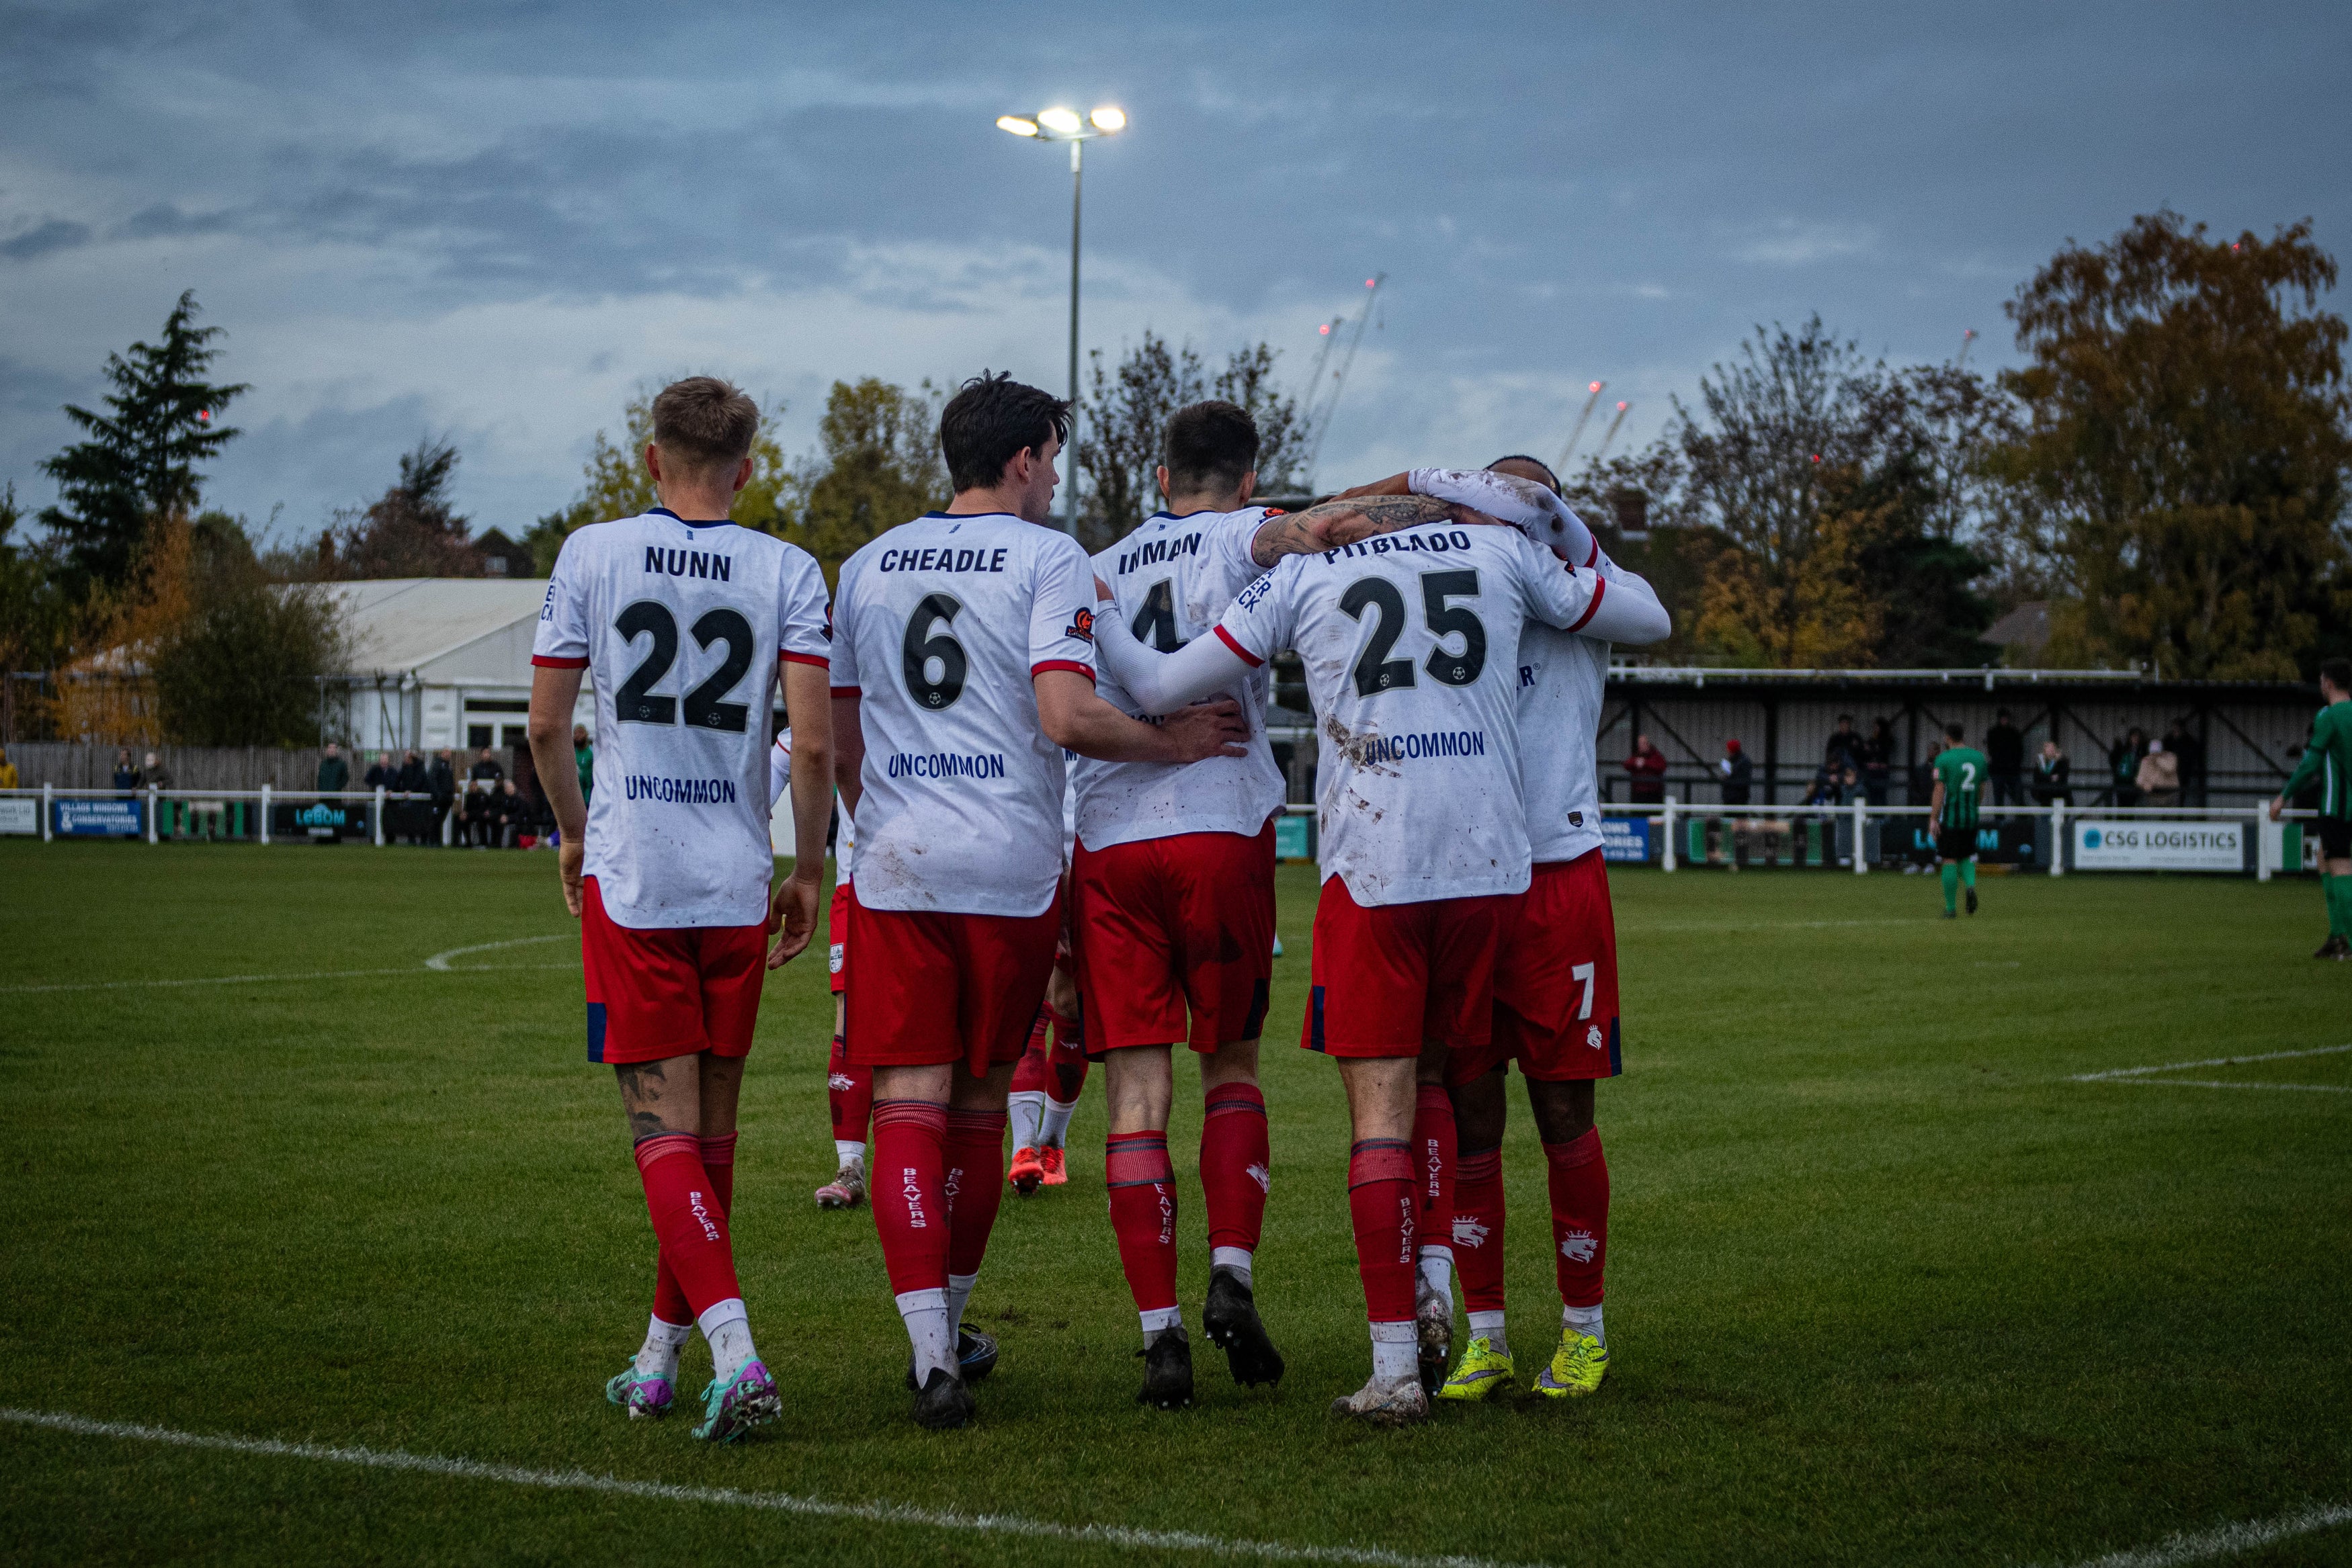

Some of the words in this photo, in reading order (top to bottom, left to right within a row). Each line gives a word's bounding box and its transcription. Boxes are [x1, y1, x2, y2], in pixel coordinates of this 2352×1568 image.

[644, 546, 731, 582] NUNN
[880, 548, 1008, 572] CHEADLE
[1118, 531, 1202, 575] INMAN
[1322, 530, 1471, 565] PITBLADO
[1130, 576, 1190, 654] 4
[1236, 590, 1260, 613] CK
[901, 591, 969, 712] 6
[1337, 568, 1488, 698] 25
[612, 598, 757, 735] 22
[888, 752, 1005, 779] UNCOMMON
[1366, 730, 1485, 766] UNCOMMON
[626, 775, 735, 803] UNCOMMON
[1962, 762, 1976, 791] 2
[60, 802, 91, 813] VILLAGE
[2105, 830, 2139, 848] CSG
[2146, 830, 2237, 849] LOGISTICS
[1571, 961, 1595, 1020] 7
[1427, 1139, 1442, 1196] BEAVERS
[690, 1191, 720, 1241] BEAVERS
[903, 1168, 927, 1227] BEAVERS
[1154, 1182, 1172, 1244] EAVERS
[1400, 1197, 1415, 1263] BEAVERS
